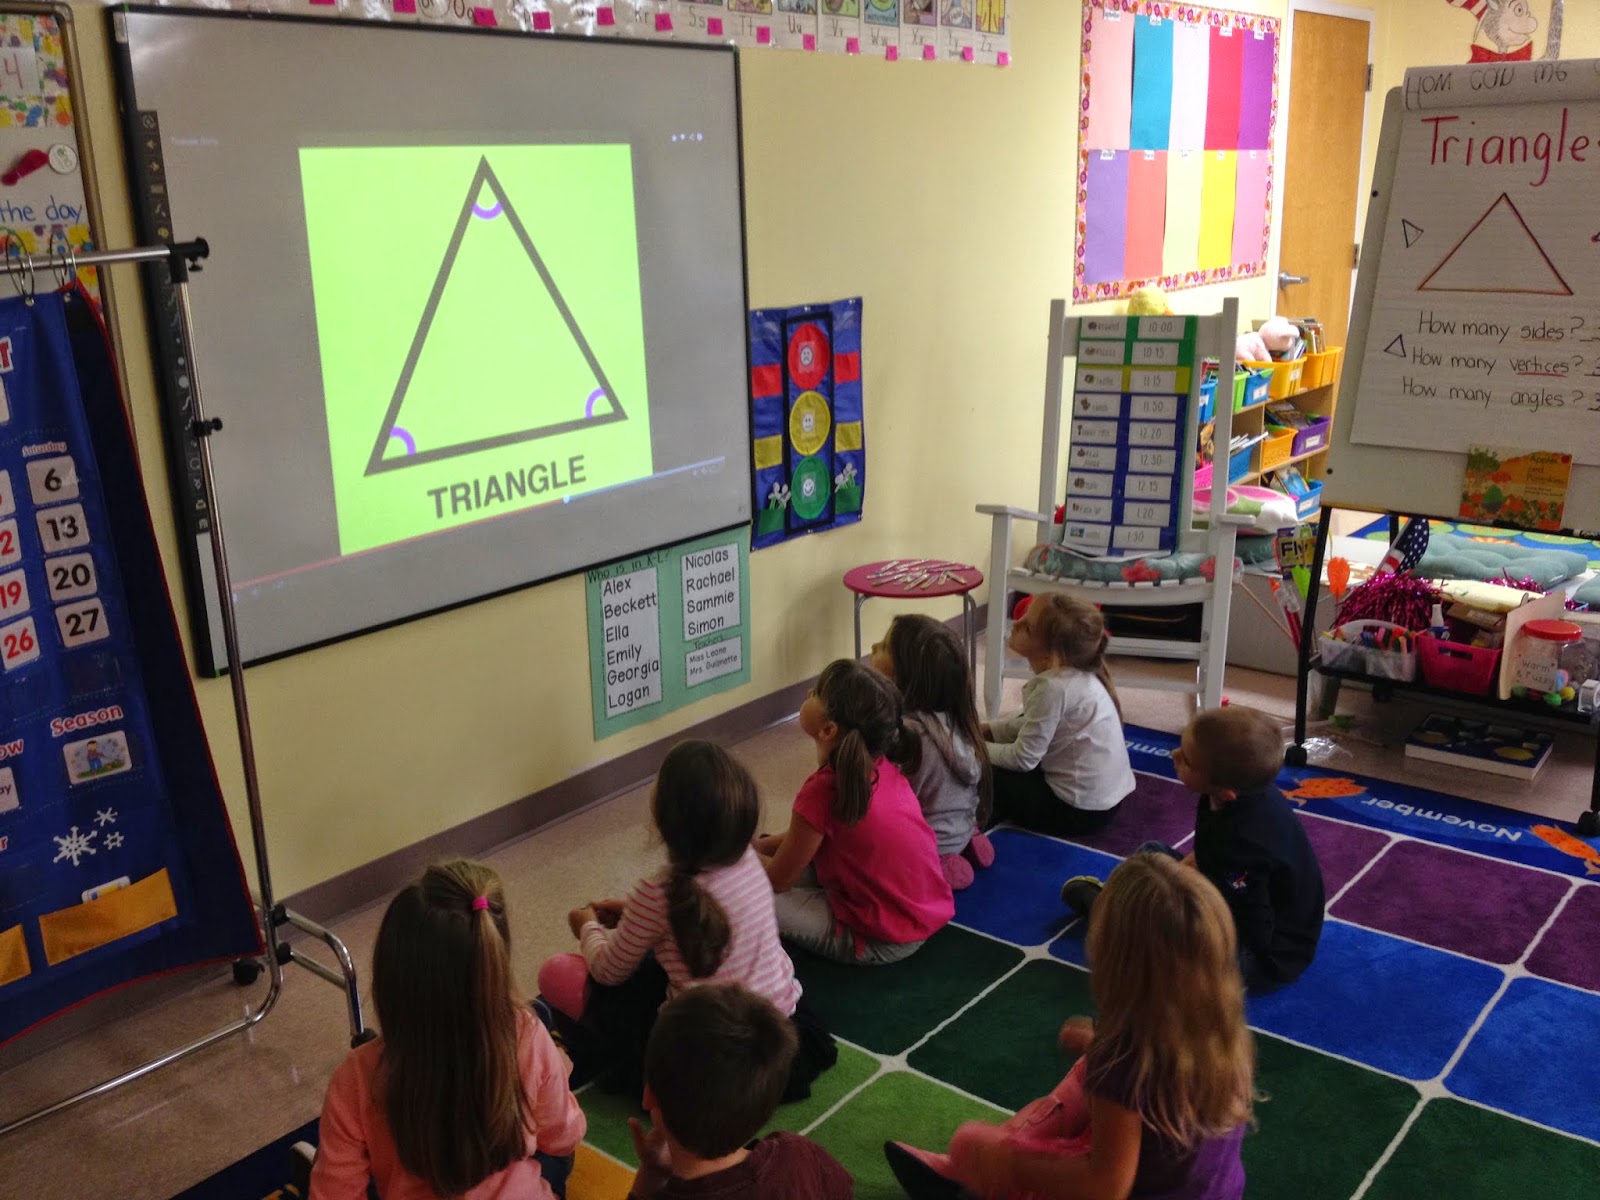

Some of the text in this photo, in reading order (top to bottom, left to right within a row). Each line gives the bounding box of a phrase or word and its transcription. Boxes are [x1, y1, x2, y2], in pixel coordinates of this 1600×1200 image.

[1421, 108, 1600, 187] Triangle
[45, 194, 82, 227] day
[1418, 311, 1456, 335] How
[1463, 320, 1510, 344] many
[1412, 347, 1442, 366] How
[1451, 357, 1496, 376] many
[1402, 376, 1437, 397] How
[1450, 386, 1492, 408] many
[44, 468, 62, 492] 6
[427, 455, 587, 519] TRIANGLE
[46, 515, 79, 541] 13
[685, 549, 729, 571] Nicolas
[0, 563, 91, 609] 19 20
[603, 577, 632, 597] Alex
[686, 567, 735, 593] Rachael
[604, 592, 657, 620] Beckett
[687, 590, 734, 614] Sammie
[4, 608, 99, 659] 26 27
[606, 625, 629, 643] Ella
[688, 616, 724, 636] Simon
[607, 644, 642, 666] Emily
[607, 659, 659, 686] Georgia
[608, 685, 650, 709] Logan
[51, 705, 123, 736] Season
[1361, 797, 1523, 842] November
